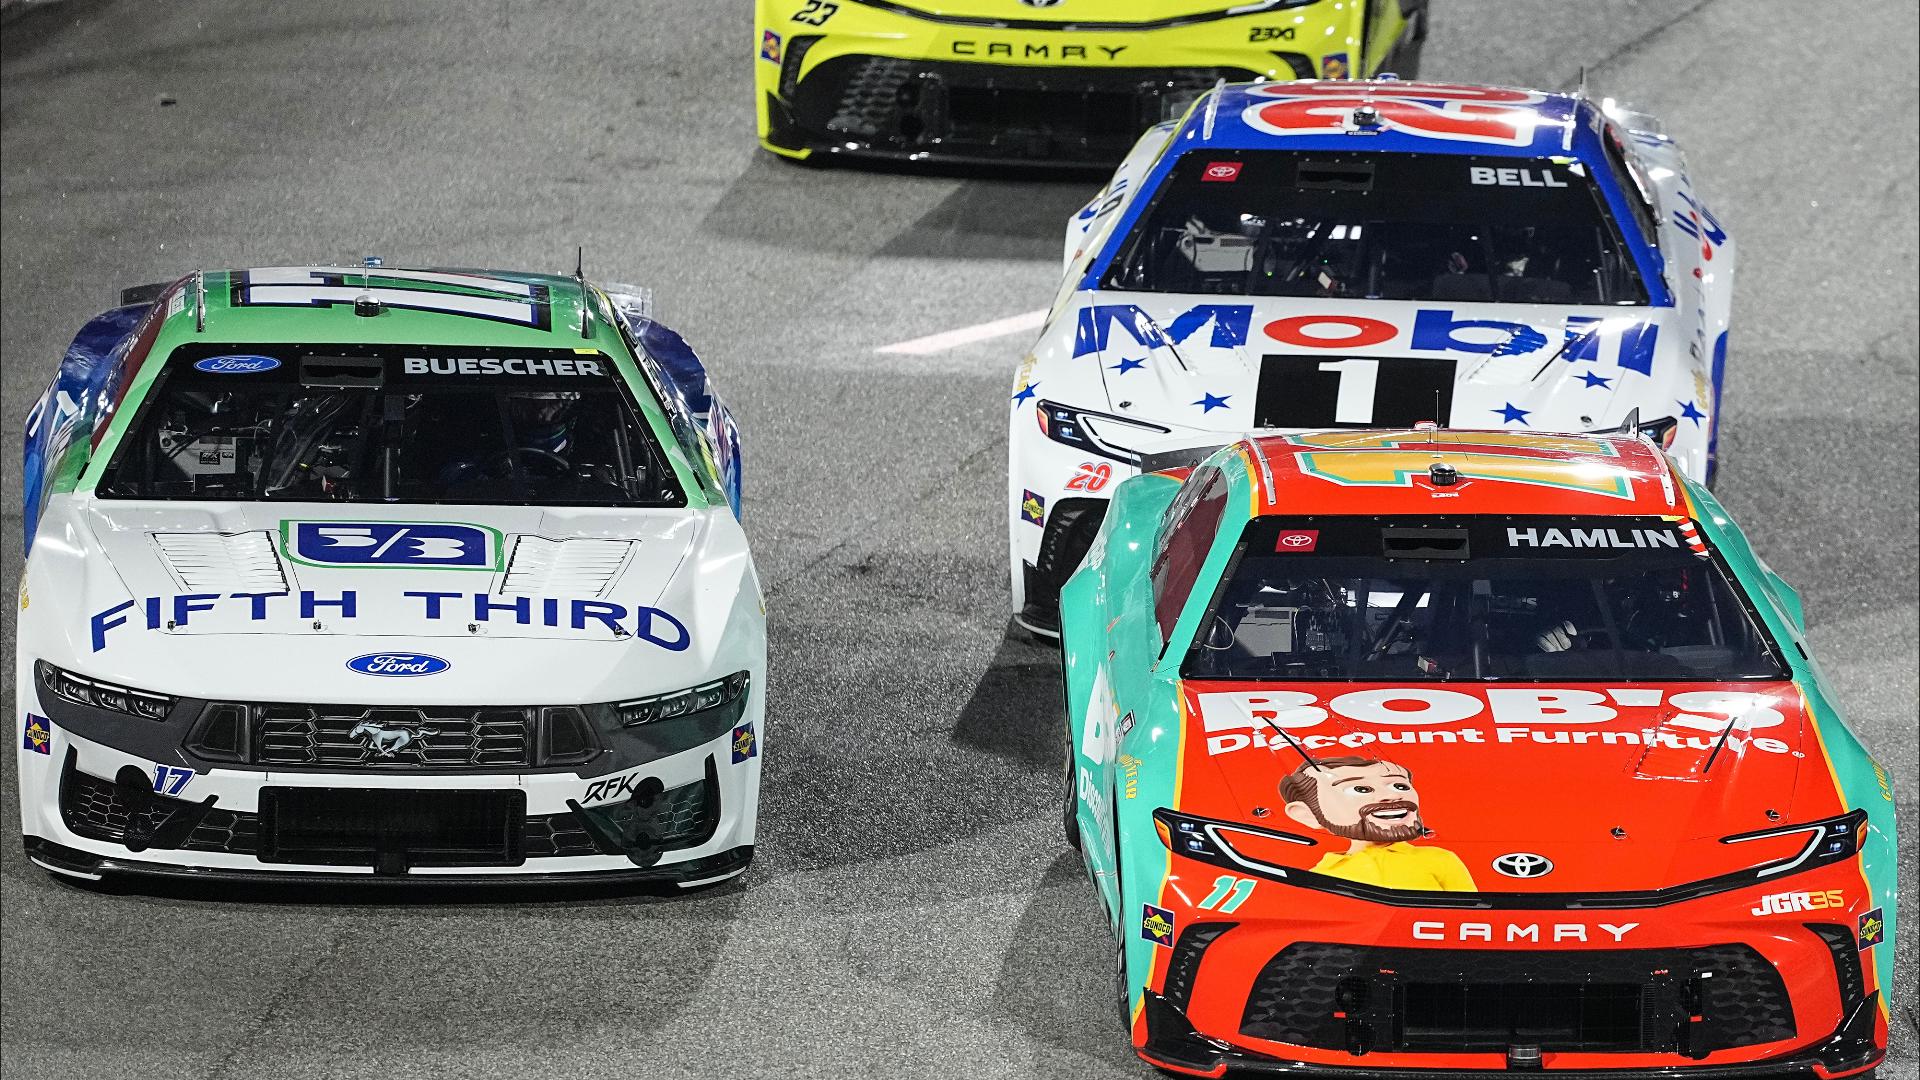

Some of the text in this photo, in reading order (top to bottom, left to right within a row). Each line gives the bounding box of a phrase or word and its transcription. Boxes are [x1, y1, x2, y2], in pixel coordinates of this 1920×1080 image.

[791, 0, 838, 26] 23
[953, 41, 1128, 59] CAMRY
[1470, 166, 1568, 188] BELL
[1072, 304, 1659, 376] Mobil
[211, 358, 263, 370] Ford
[404, 358, 603, 376] BUESCHER
[1318, 359, 1379, 424] 1
[1064, 462, 1112, 493] 20
[318, 527, 465, 558] 5/3
[1506, 527, 1680, 548] HAMLIN
[91, 590, 357, 653] FIFTH
[403, 591, 690, 651] THIRD
[366, 655, 428, 673] Ford
[1197, 688, 1785, 733] BOB'S
[1207, 728, 1486, 757] Discount
[153, 764, 196, 796] 17
[581, 771, 639, 804] RFK
[1197, 875, 1258, 914] 11
[1751, 889, 1845, 917] JGR35
[1145, 918, 1172, 935] SUNOCO
[1413, 921, 1640, 943] CAMRY
